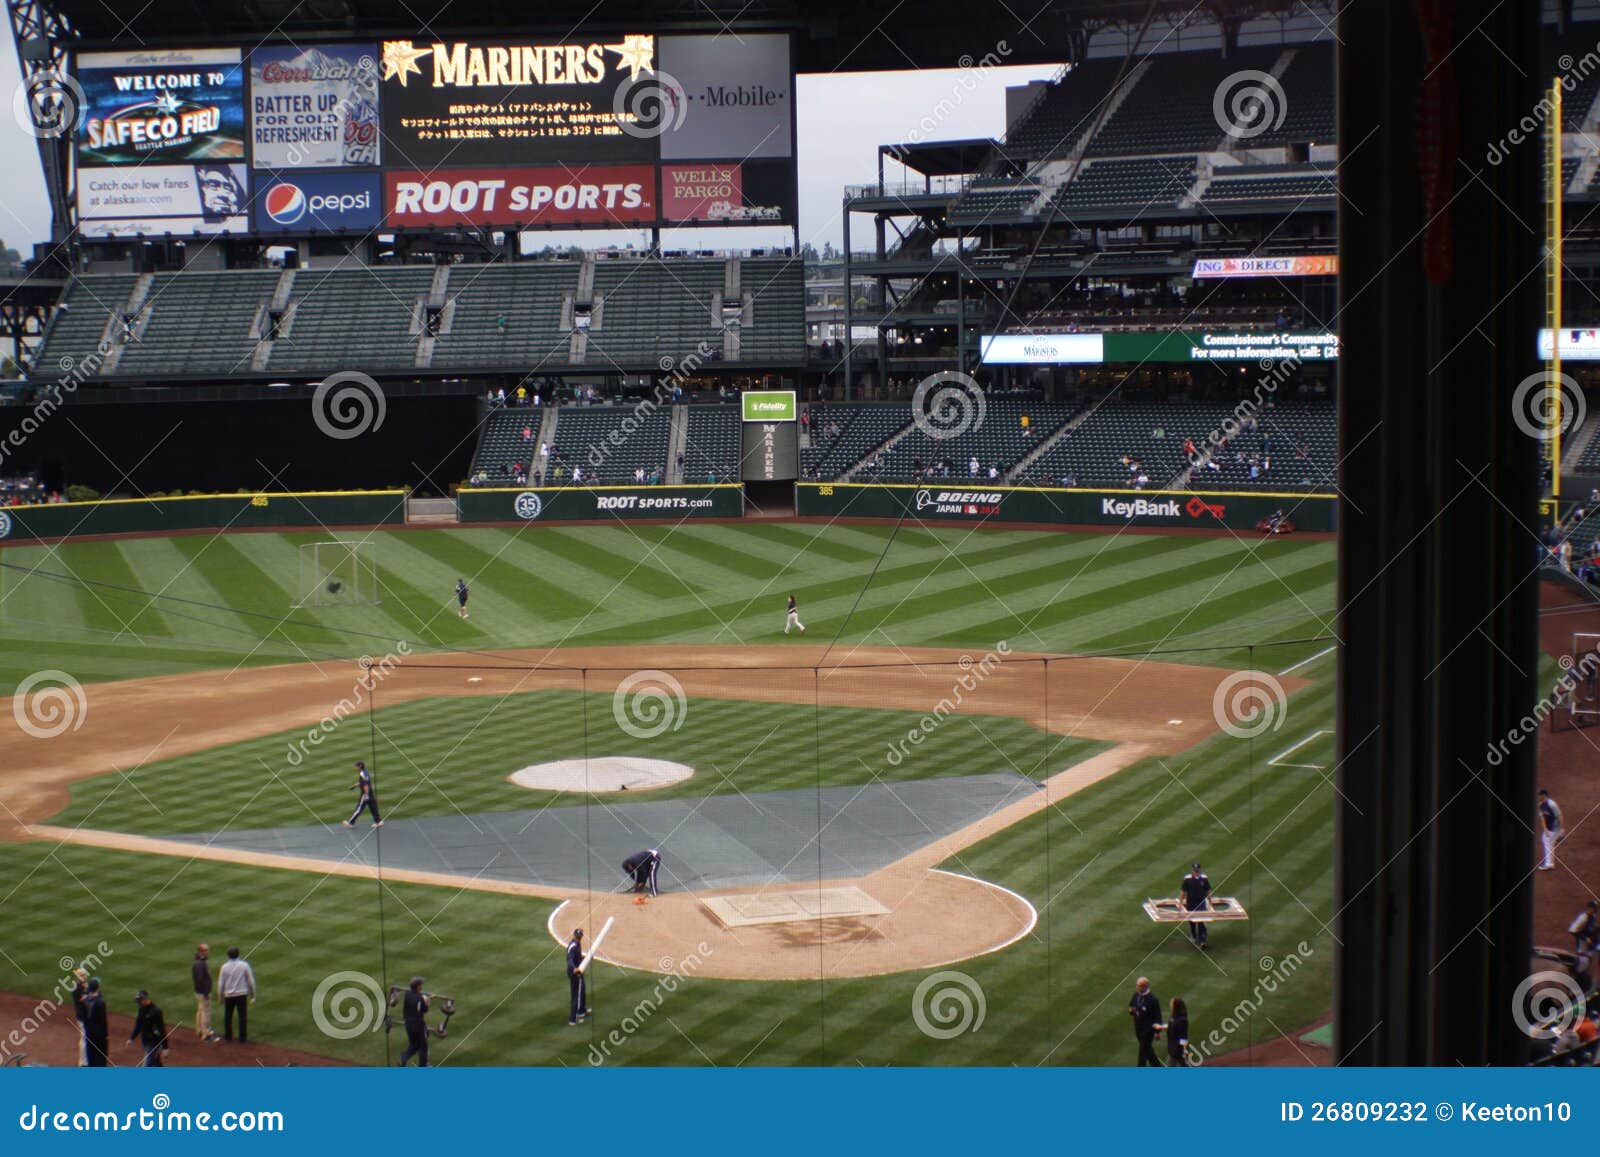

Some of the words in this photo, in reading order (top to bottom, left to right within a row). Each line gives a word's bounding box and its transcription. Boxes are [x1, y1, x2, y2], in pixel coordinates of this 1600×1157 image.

[431, 43, 605, 87] MARINERS
[114, 73, 201, 91] WELCOME
[207, 72, 225, 85] TO
[255, 95, 312, 113] BATTER
[318, 94, 338, 112] UP
[255, 115, 288, 125] FOR
[294, 114, 338, 125] COLD
[87, 115, 178, 149] SAFECO
[180, 106, 221, 136] FIELD
[672, 170, 732, 183] WELLS
[89, 179, 119, 191] Catch
[121, 182, 139, 190] our
[142, 179, 160, 190] low
[163, 178, 190, 189] fares
[395, 180, 505, 213] ROOT
[508, 183, 642, 211] SPORTS
[673, 185, 732, 198] FARGO
[89, 196, 100, 205] at
[309, 190, 370, 214] pepsi
[1198, 261, 1221, 272] ING
[1241, 259, 1290, 270] DIRECT
[1203, 333, 1280, 346] Commissioner's
[1281, 333, 1339, 347] Community
[1191, 347, 1209, 358] For
[1209, 348, 1236, 358] more
[759, 402, 787, 411] Fidelity
[763, 424, 776, 480] MARINERS
[818, 486, 834, 496] 385
[936, 492, 1002, 503] BOEING
[519, 498, 536, 511] 35
[597, 496, 638, 509] ROOT
[638, 497, 713, 509] SPORTS.com
[936, 504, 962, 513] JAPAN
[1102, 498, 1181, 518] KeyBank
